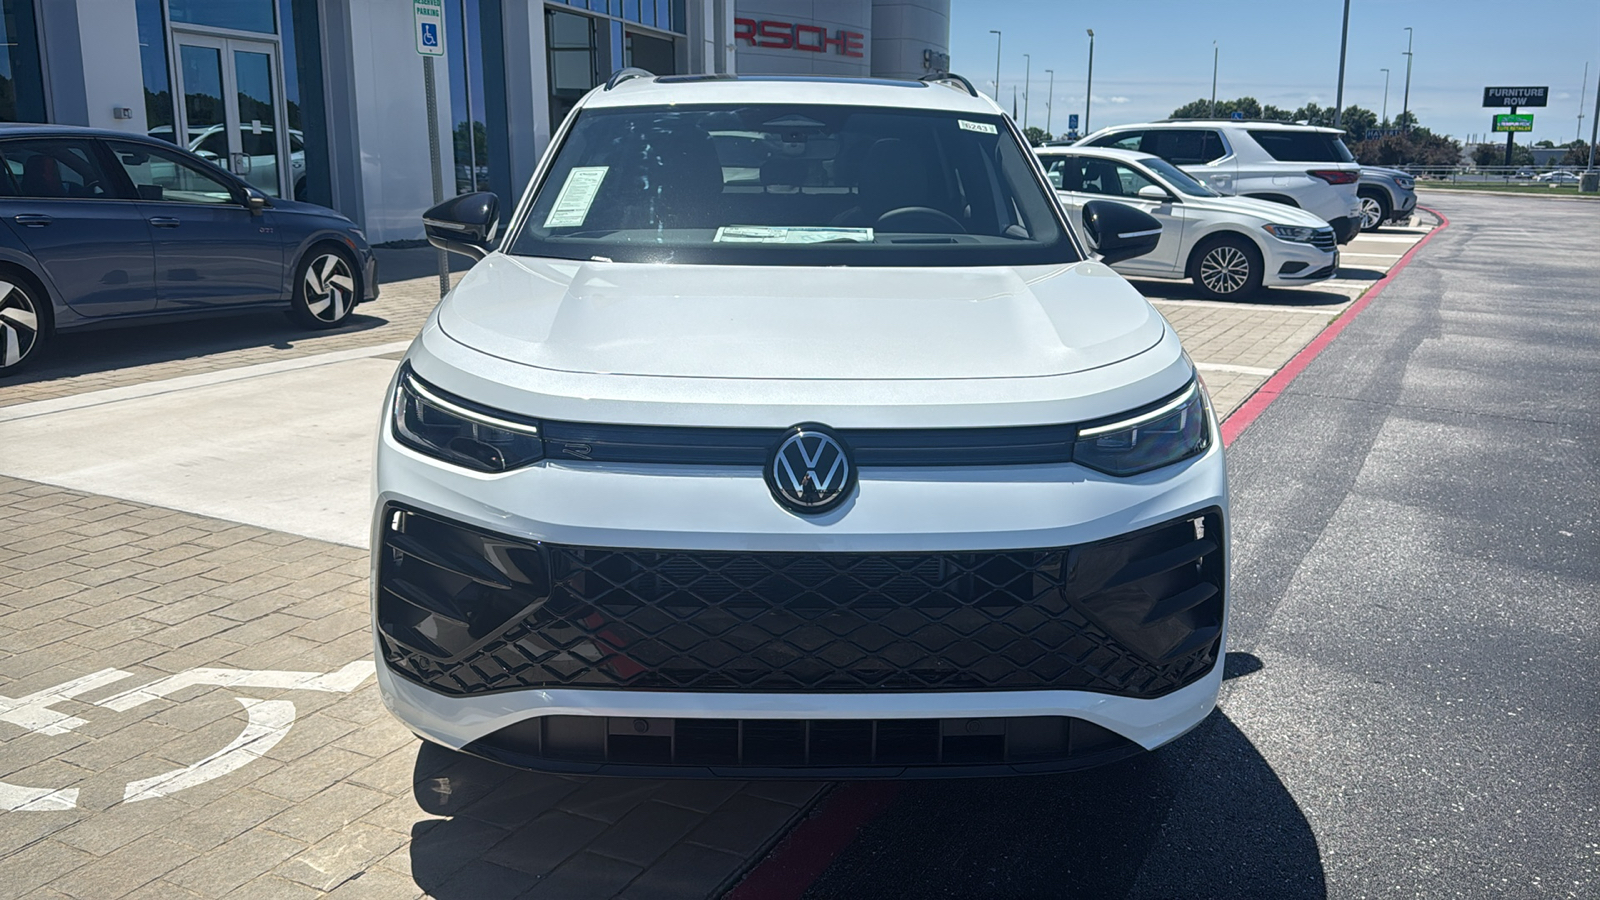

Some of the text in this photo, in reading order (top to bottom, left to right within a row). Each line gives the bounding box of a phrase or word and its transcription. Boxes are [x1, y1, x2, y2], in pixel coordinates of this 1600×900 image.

[416, 7, 440, 17] PARKING
[734, 17, 864, 58] RSCHE
[1489, 88, 1545, 97] FURNITURE
[1503, 97, 1528, 105] ROW
